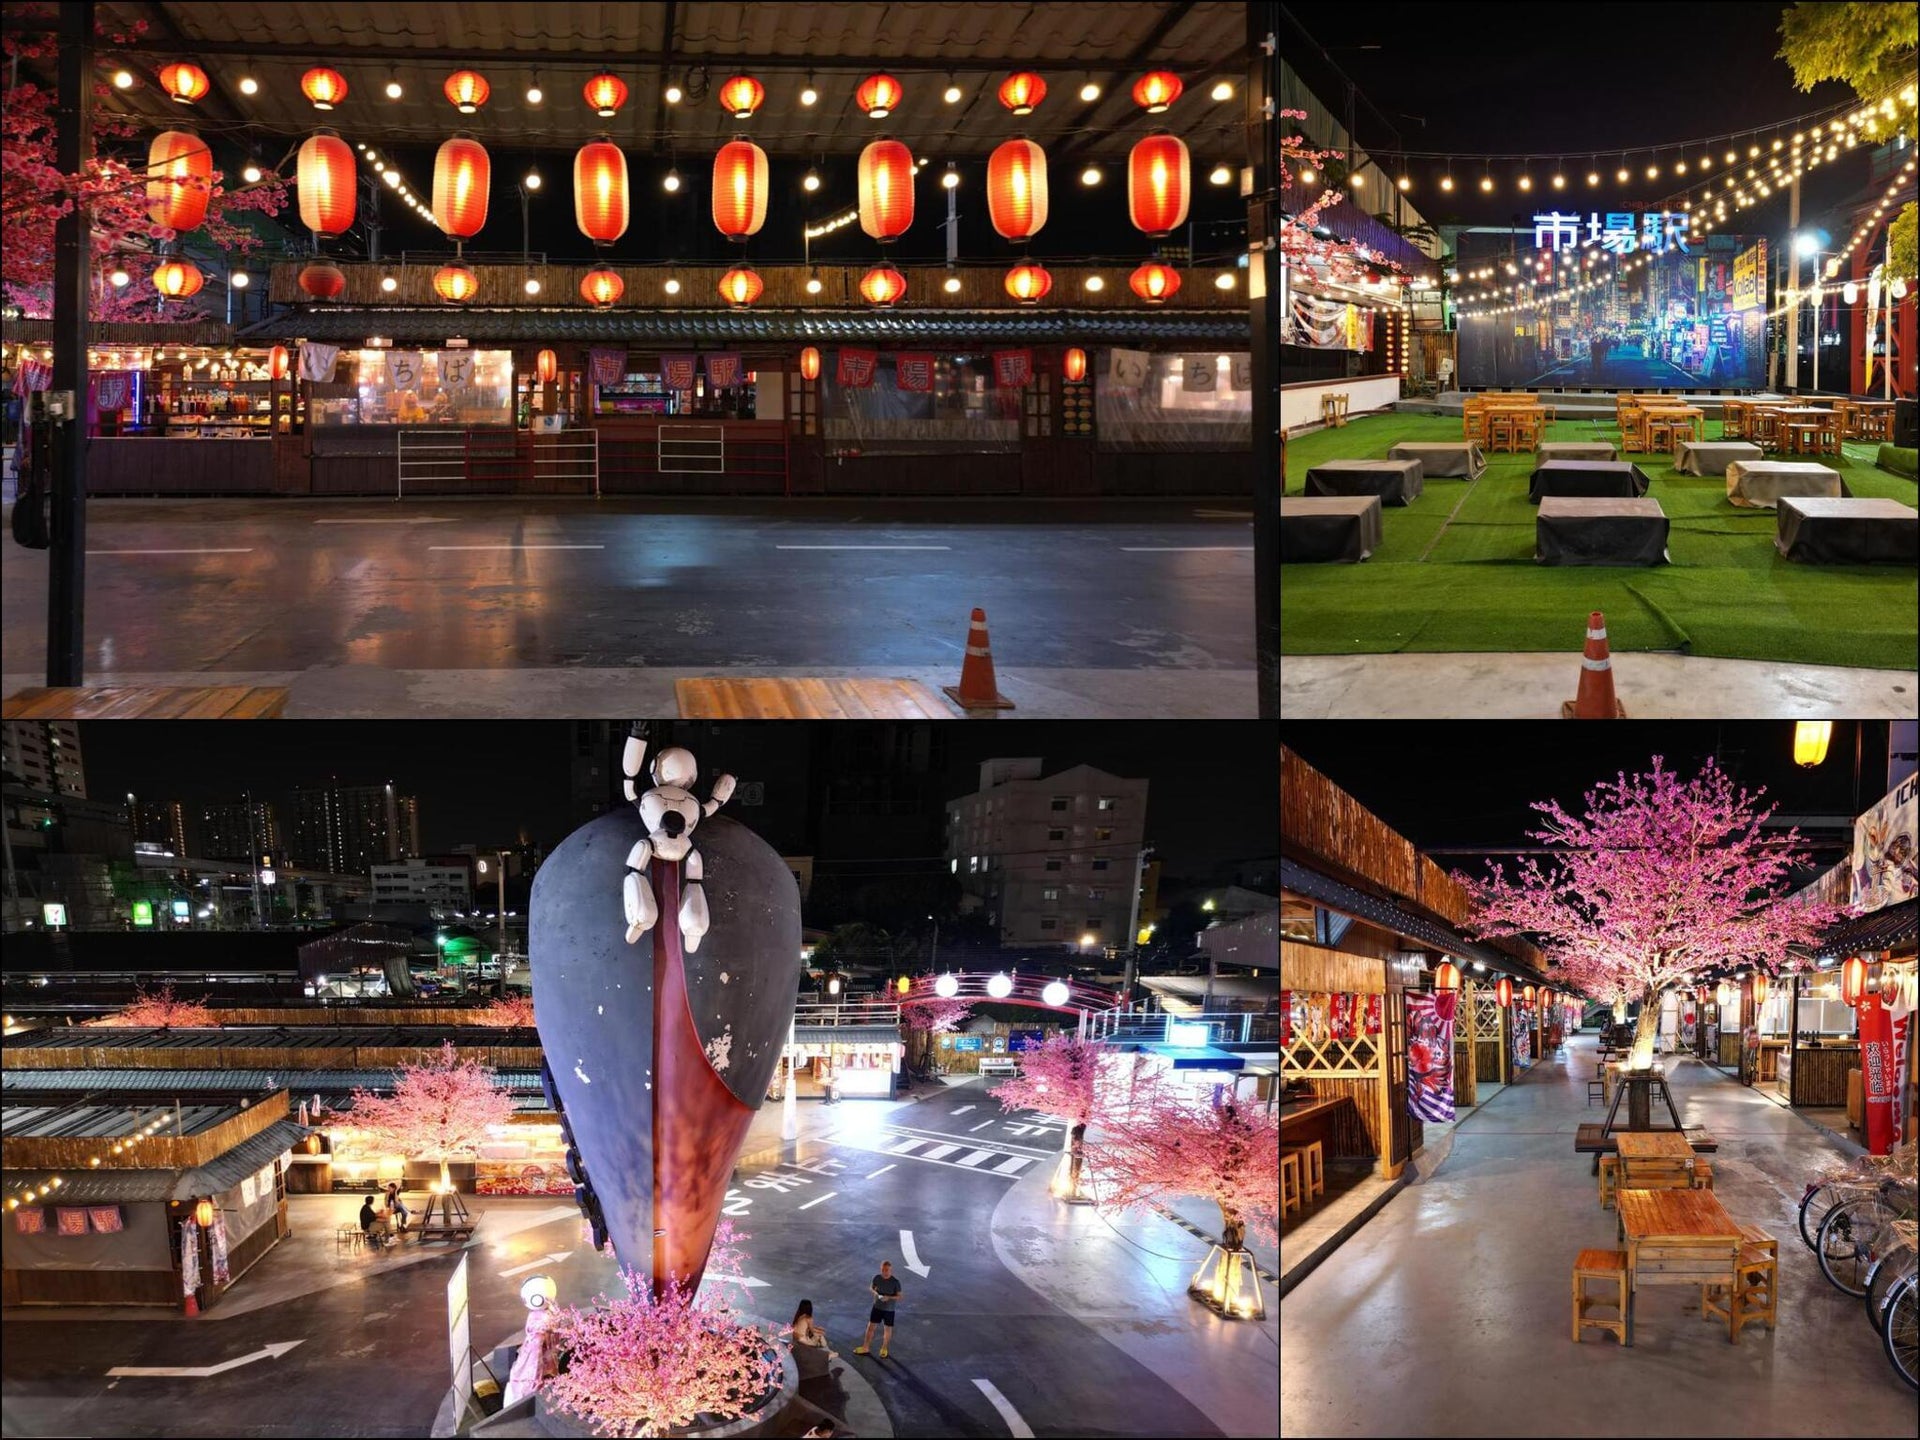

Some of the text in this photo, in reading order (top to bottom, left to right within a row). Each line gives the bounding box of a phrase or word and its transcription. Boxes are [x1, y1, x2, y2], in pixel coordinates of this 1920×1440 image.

[1533, 212, 1691, 254] 市場駅
[1866, 1041, 1885, 1094] 欢迎光临
